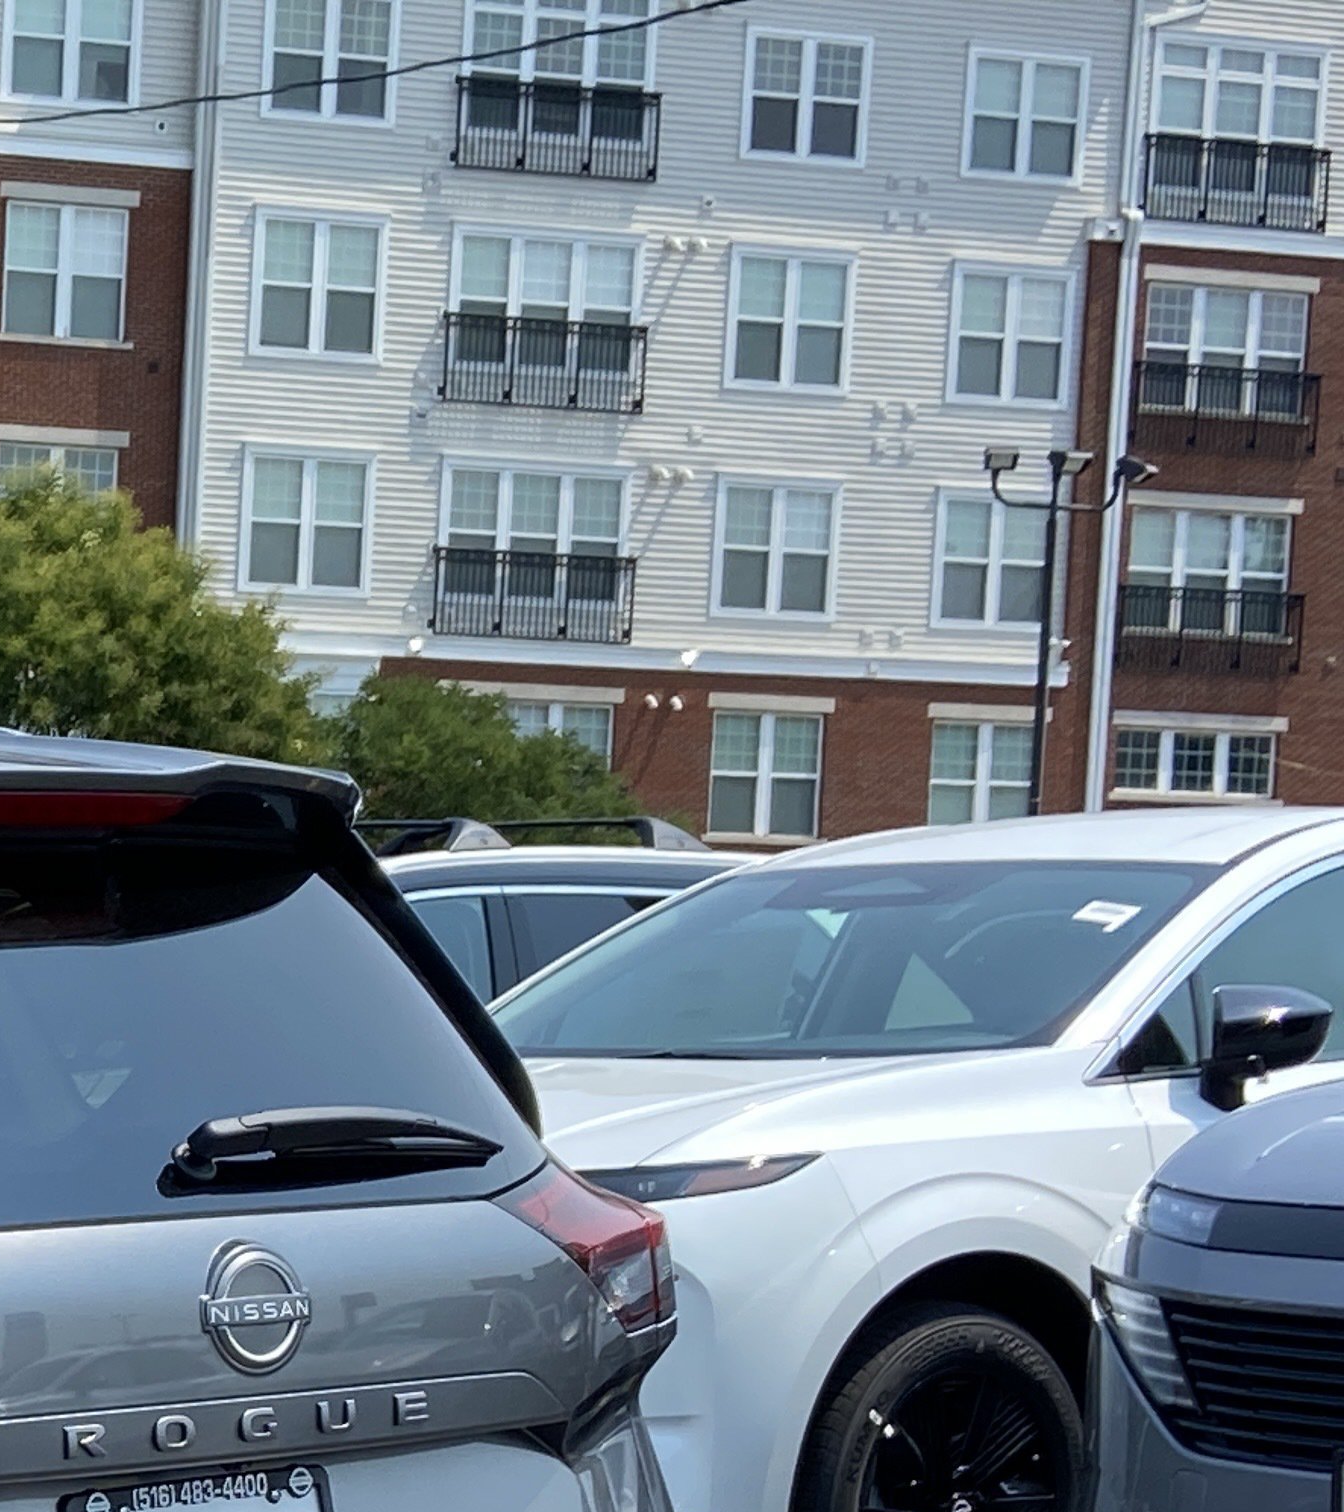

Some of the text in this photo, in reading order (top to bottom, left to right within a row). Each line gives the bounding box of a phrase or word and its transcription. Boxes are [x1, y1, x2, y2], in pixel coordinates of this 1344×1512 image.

[210, 1299, 310, 1324] NISSAN
[63, 1390, 430, 1460] ROGUE
[131, 1472, 268, 1511] (516) 483-4400
